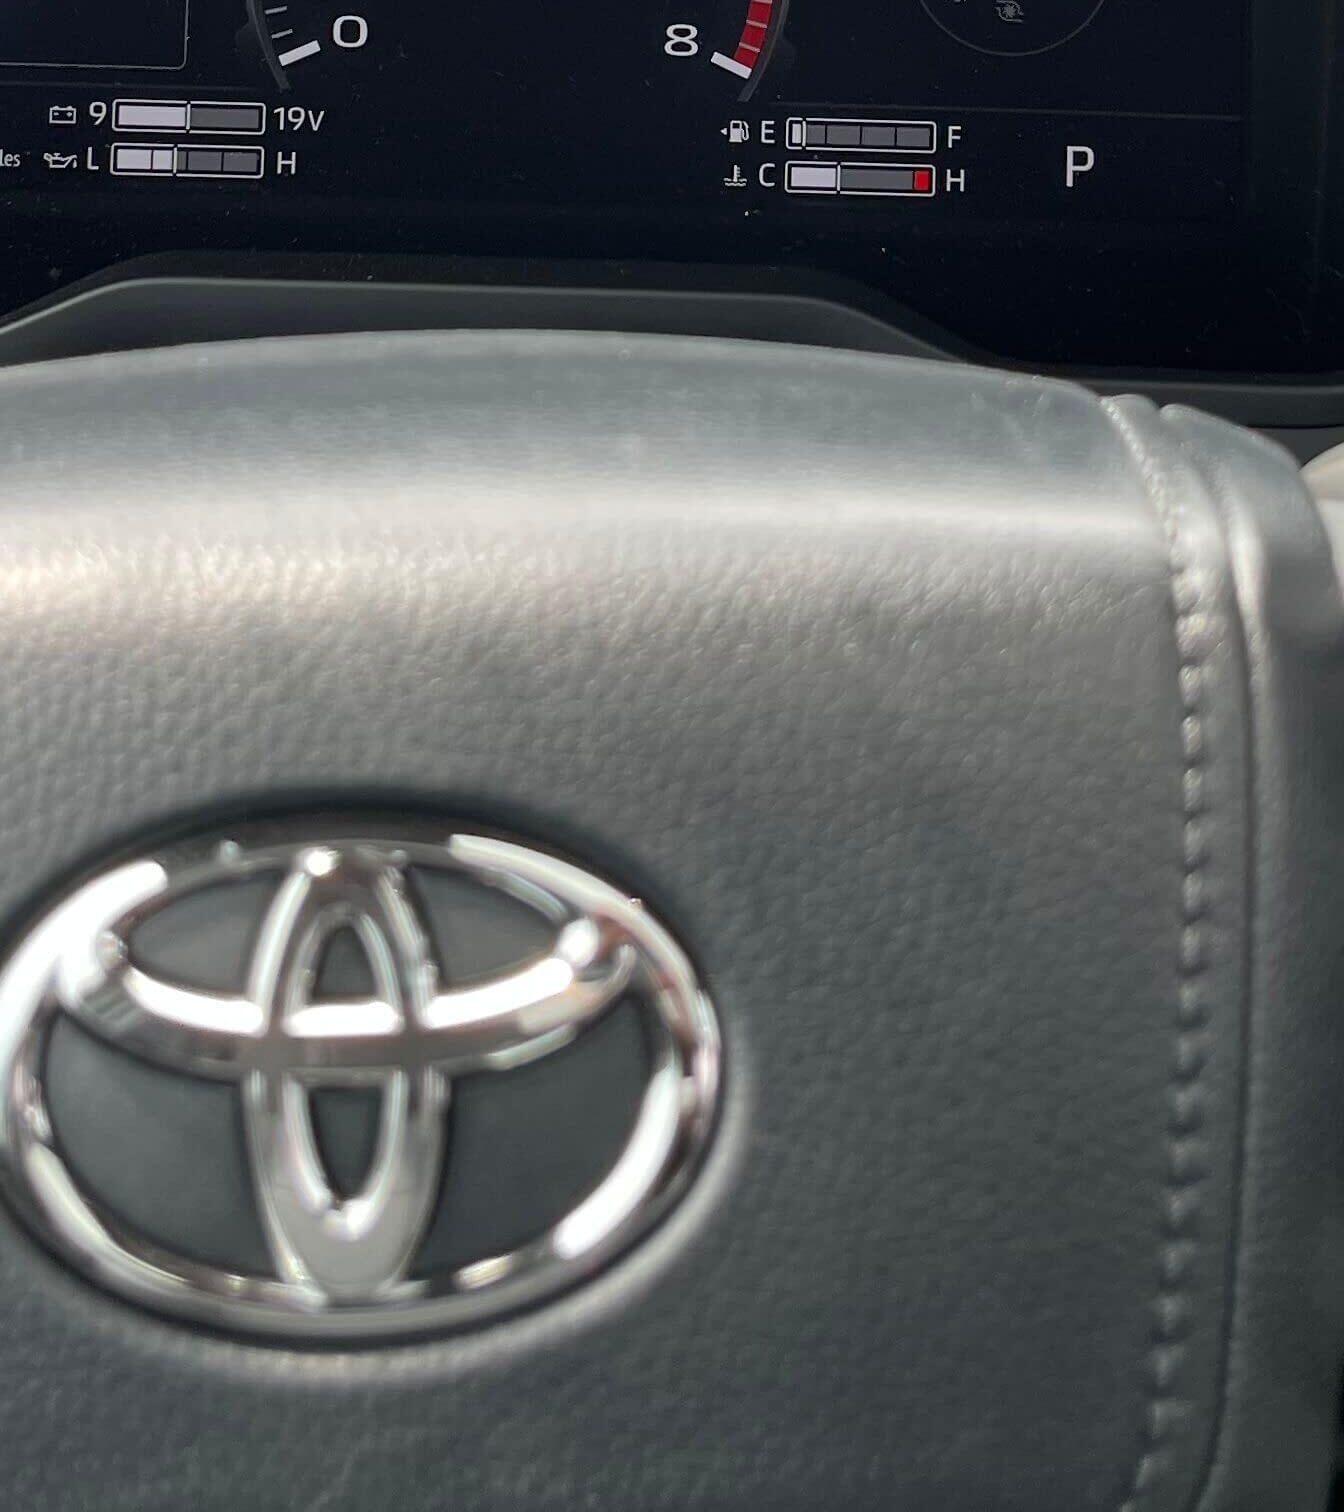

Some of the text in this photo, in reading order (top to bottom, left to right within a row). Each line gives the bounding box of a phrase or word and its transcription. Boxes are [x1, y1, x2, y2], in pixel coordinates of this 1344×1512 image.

[333, 14, 368, 47] 0
[664, 23, 699, 56] 8
[89, 102, 107, 127] 9
[760, 120, 775, 144] E
[947, 126, 962, 149] F
[87, 148, 99, 170] L
[277, 151, 296, 174] H
[1065, 146, 1095, 188] P
[758, 163, 776, 188] C
[945, 169, 966, 192] H
